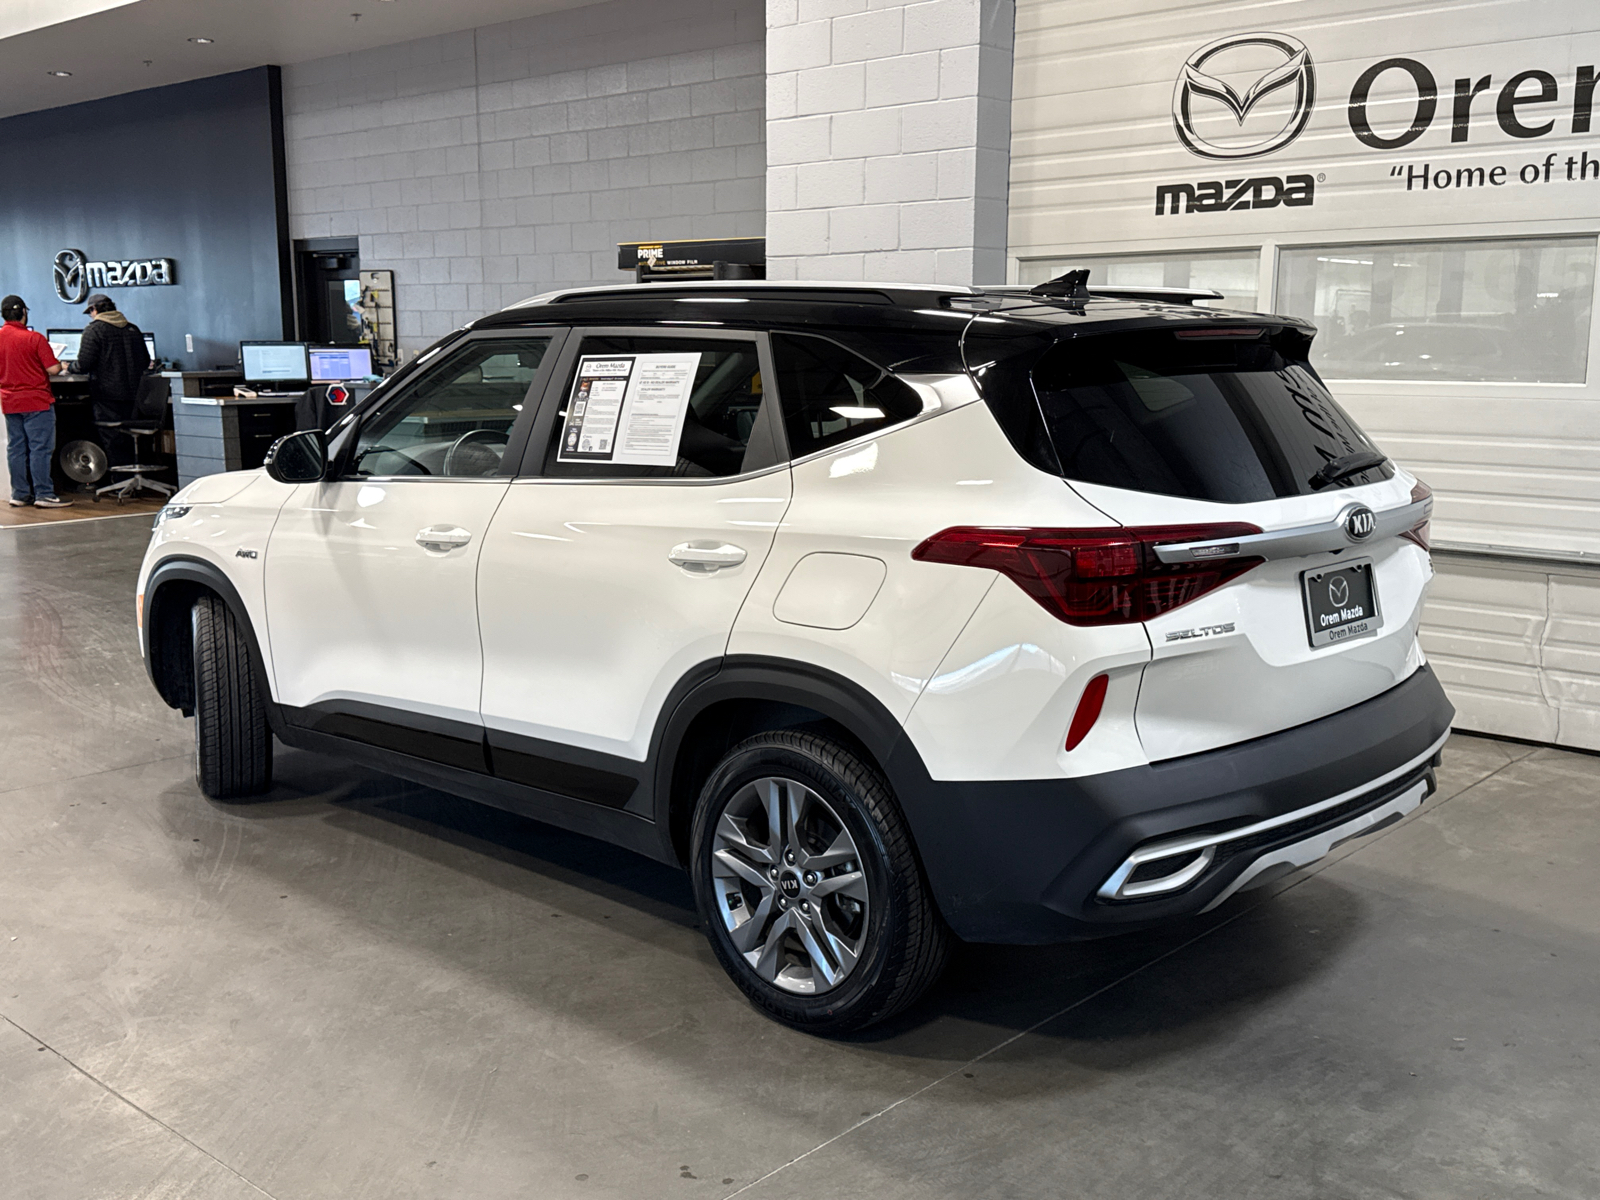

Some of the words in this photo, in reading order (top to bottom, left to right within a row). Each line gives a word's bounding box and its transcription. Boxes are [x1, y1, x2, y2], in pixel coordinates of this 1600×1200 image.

[1519, 152, 1558, 184] of
[637, 248, 664, 259] PRIME
[1352, 513, 1375, 534] KIA
[235, 548, 258, 560] AWD
[1320, 613, 1340, 627] Orem
[1340, 605, 1364, 621] Mazda
[1165, 622, 1236, 642] SELTOS
[1329, 629, 1347, 640] Orem
[1347, 621, 1368, 635] Mazda
[781, 879, 798, 890] KIA
